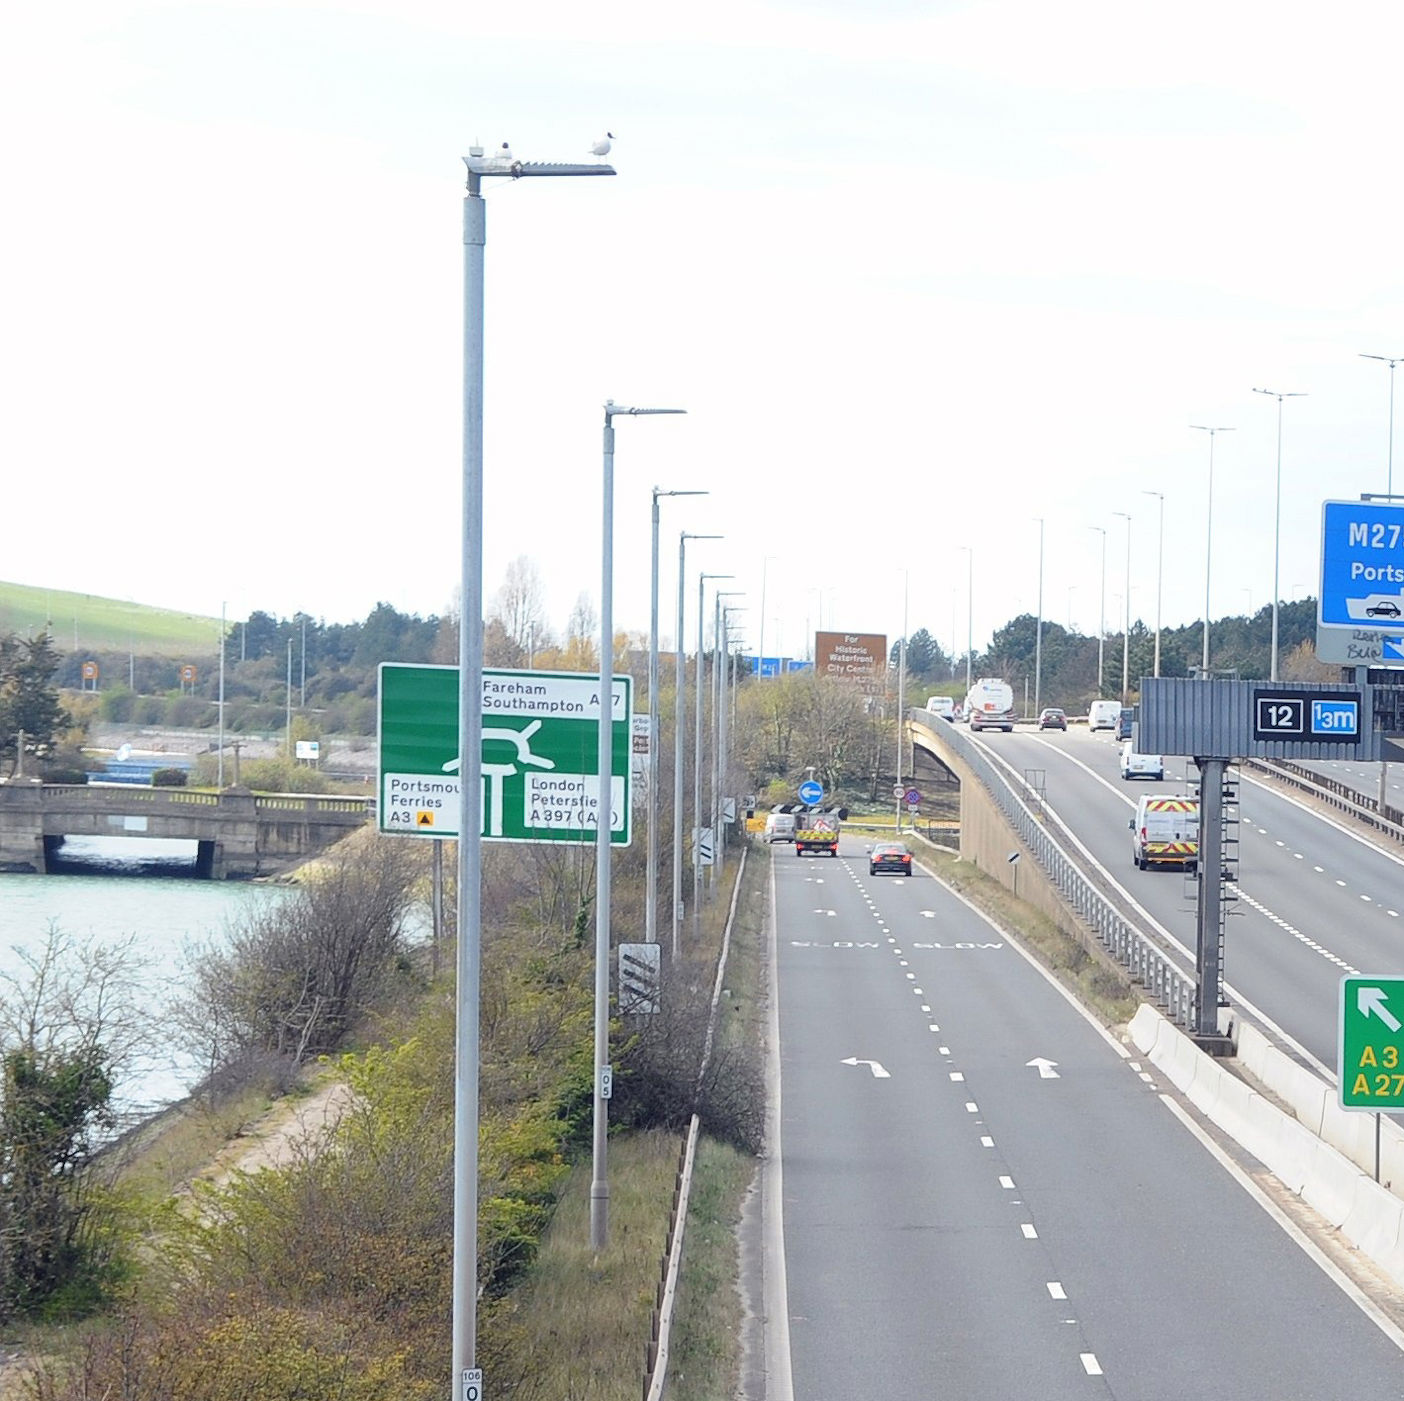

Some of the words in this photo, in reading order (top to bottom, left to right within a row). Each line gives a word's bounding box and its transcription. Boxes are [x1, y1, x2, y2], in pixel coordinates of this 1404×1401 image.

[829, 653, 874, 663] Waterfront
[482, 680, 547, 696] Fareham
[482, 695, 584, 713] Southampton
[589, 693, 621, 707] A7
[1267, 705, 1294, 728] 12
[531, 777, 584, 791] London
[391, 794, 443, 809] Ferries
[531, 792, 598, 808] Petersfie
[390, 810, 411, 824] A3
[530, 809, 572, 823] A397
[577, 809, 618, 826] (A)
[912, 941, 1004, 950] SLOW
[1359, 1046, 1399, 1069] A3
[463, 1370, 481, 1381] 106
